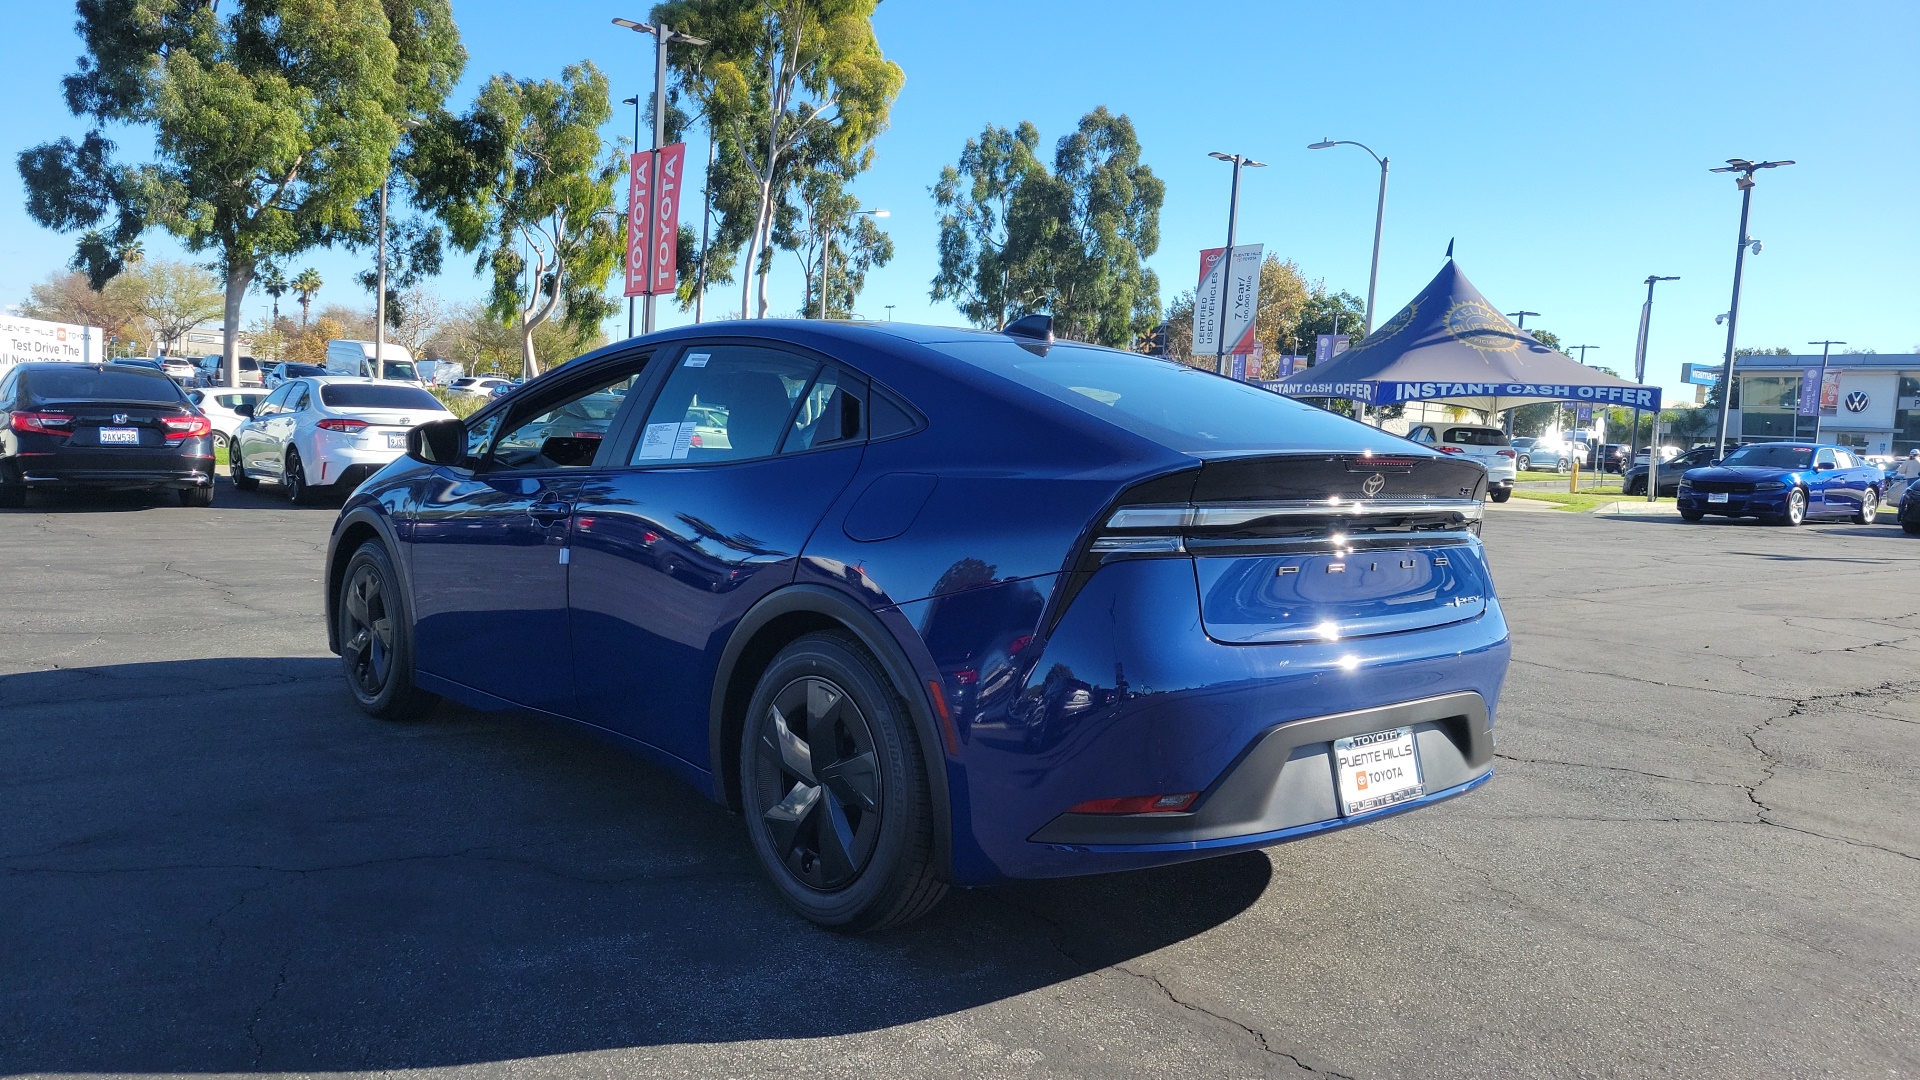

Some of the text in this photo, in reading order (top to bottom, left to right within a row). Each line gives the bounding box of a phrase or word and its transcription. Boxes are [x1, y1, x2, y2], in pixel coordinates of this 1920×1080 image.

[631, 161, 648, 288] TOYOTA
[658, 154, 678, 286] TOYOTA
[1235, 277, 1246, 310] Year/
[1206, 272, 1219, 344] USED VEHICLES
[1243, 294, 1251, 323] 100,000
[1454, 306, 1501, 323] KELLEY
[1198, 297, 1208, 344] CERTIFIED
[1453, 322, 1510, 334] BLUE BOOK
[11, 338, 80, 357] Test Drive The
[1692, 369, 1718, 381] Walmar
[1304, 383, 1333, 394] CASH
[1335, 383, 1373, 400] OFFER
[1396, 383, 1653, 407] INSTANT CASH OFFER
[1278, 557, 1448, 576] PRIUS
[1354, 730, 1399, 746] TOYOTA
[1340, 745, 1413, 769] PUENTE HILLS
[1369, 767, 1404, 783] TOYOTA
[1350, 787, 1423, 813] PUENTE HILLS
